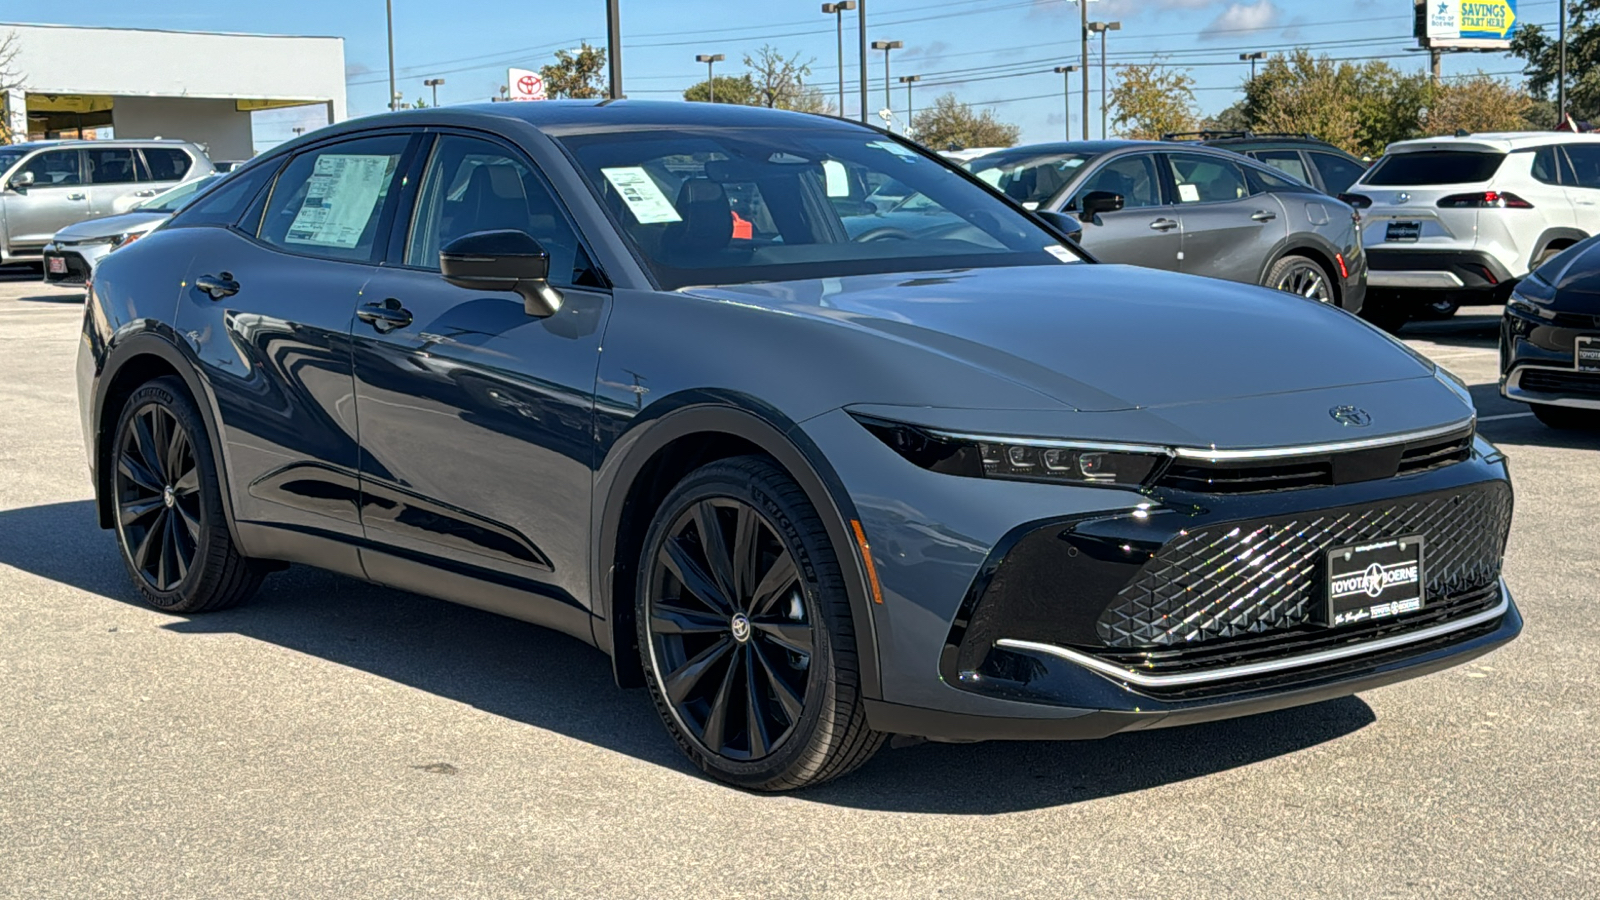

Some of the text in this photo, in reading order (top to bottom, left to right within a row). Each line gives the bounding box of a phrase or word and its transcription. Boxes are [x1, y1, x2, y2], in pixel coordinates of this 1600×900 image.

[1461, 2, 1506, 18] SAVINGS
[1461, 17, 1506, 29] START HERE
[141, 388, 171, 402] MICHELIN
[764, 500, 816, 578] MICHELIN
[1331, 577, 1370, 594] TOYOTA
